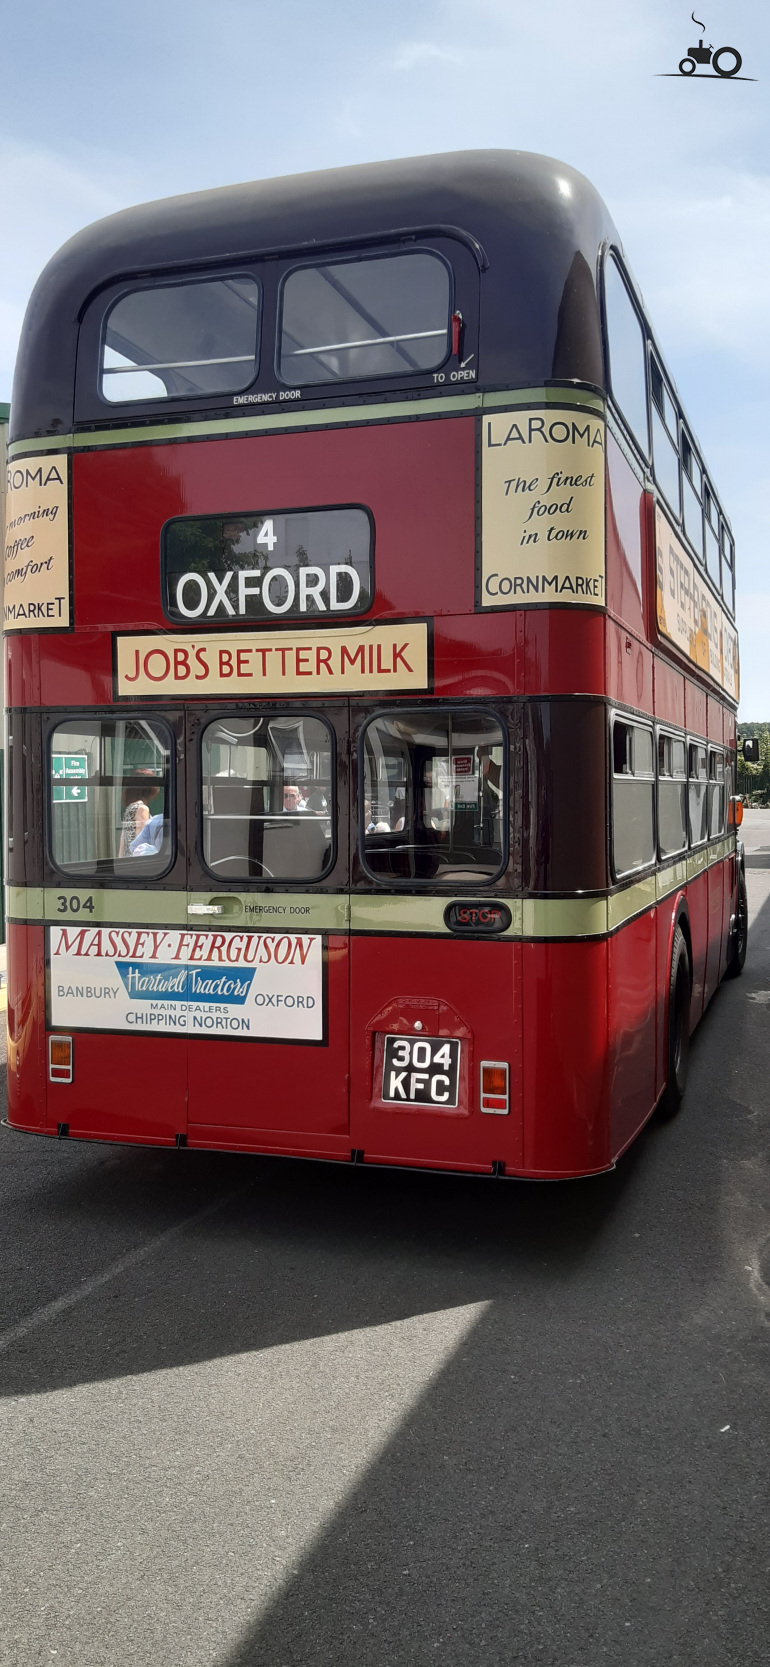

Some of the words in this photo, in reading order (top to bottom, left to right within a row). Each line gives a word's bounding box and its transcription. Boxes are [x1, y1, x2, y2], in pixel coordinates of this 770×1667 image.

[433, 373, 445, 383] TO
[450, 370, 476, 382] OPEN
[233, 392, 276, 405] EMERGENCY
[279, 390, 301, 400] DOOR
[504, 477, 538, 496] The
[540, 471, 595, 495] finest
[523, 496, 574, 524] food
[256, 519, 278, 551] 4
[520, 529, 539, 546] in
[547, 526, 589, 542] town
[6, 555, 54, 585] comfort
[176, 564, 361, 618] OXFORD
[485, 573, 604, 598] CORNMARKET
[124, 644, 210, 683] JOB'S
[218, 647, 334, 679] BETTER
[340, 642, 414, 675] MILK
[57, 895, 95, 914] 304
[244, 905, 287, 915] EMERGENCY
[289, 906, 311, 915] DOOR
[458, 908, 501, 923] STOP
[57, 985, 120, 999] BANBURY
[127, 966, 188, 994] Hartwell
[189, 968, 251, 997] Tractors
[150, 1002, 177, 1012] MAIN
[180, 1004, 229, 1014] DEALERS
[254, 993, 316, 1009] OXFORD
[125, 1012, 187, 1027] CHIPPING
[192, 1015, 250, 1031] NORTON
[392, 1040, 452, 1071] 304
[389, 1071, 450, 1102] KFC
